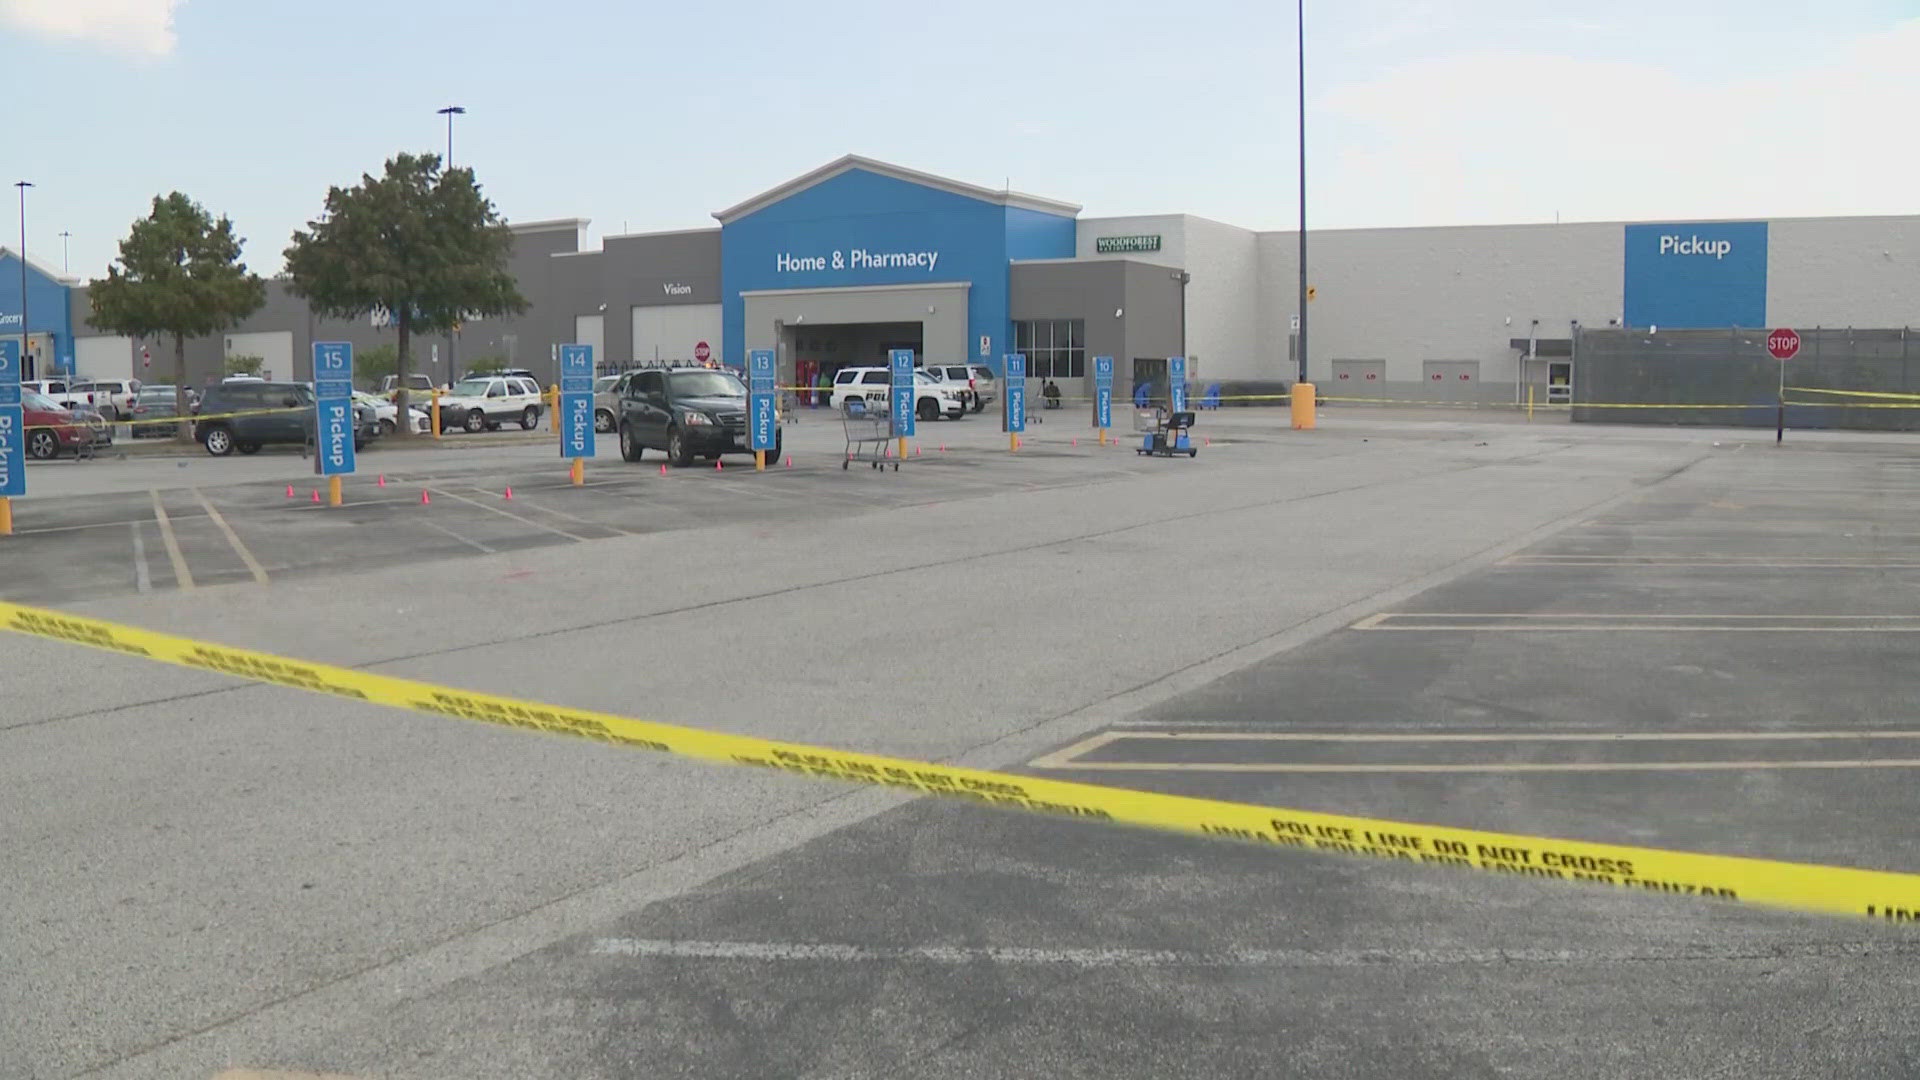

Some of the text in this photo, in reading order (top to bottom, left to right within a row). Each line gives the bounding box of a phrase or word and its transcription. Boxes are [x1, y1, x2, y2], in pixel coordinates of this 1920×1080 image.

[1098, 237, 1158, 247] WOODFOREST
[1660, 235, 1731, 260] Pickup
[777, 249, 938, 272] Home & Pharmacy
[663, 283, 692, 295] Vision
[1769, 337, 1798, 350] STOP
[325, 351, 343, 369] 15
[569, 352, 585, 367] 14
[757, 357, 769, 370] 13
[898, 356, 909, 367] 12
[1012, 361, 1020, 371] 11
[1100, 362, 1109, 371] 10
[865, 392, 886, 401] POL
[1012, 391, 1021, 428] Pickup
[570, 399, 588, 451] Pickup
[758, 398, 770, 444] Pickup
[329, 405, 346, 467] Pickup
[1270, 819, 1634, 875] POLICE LINE DO NOT CROSS
